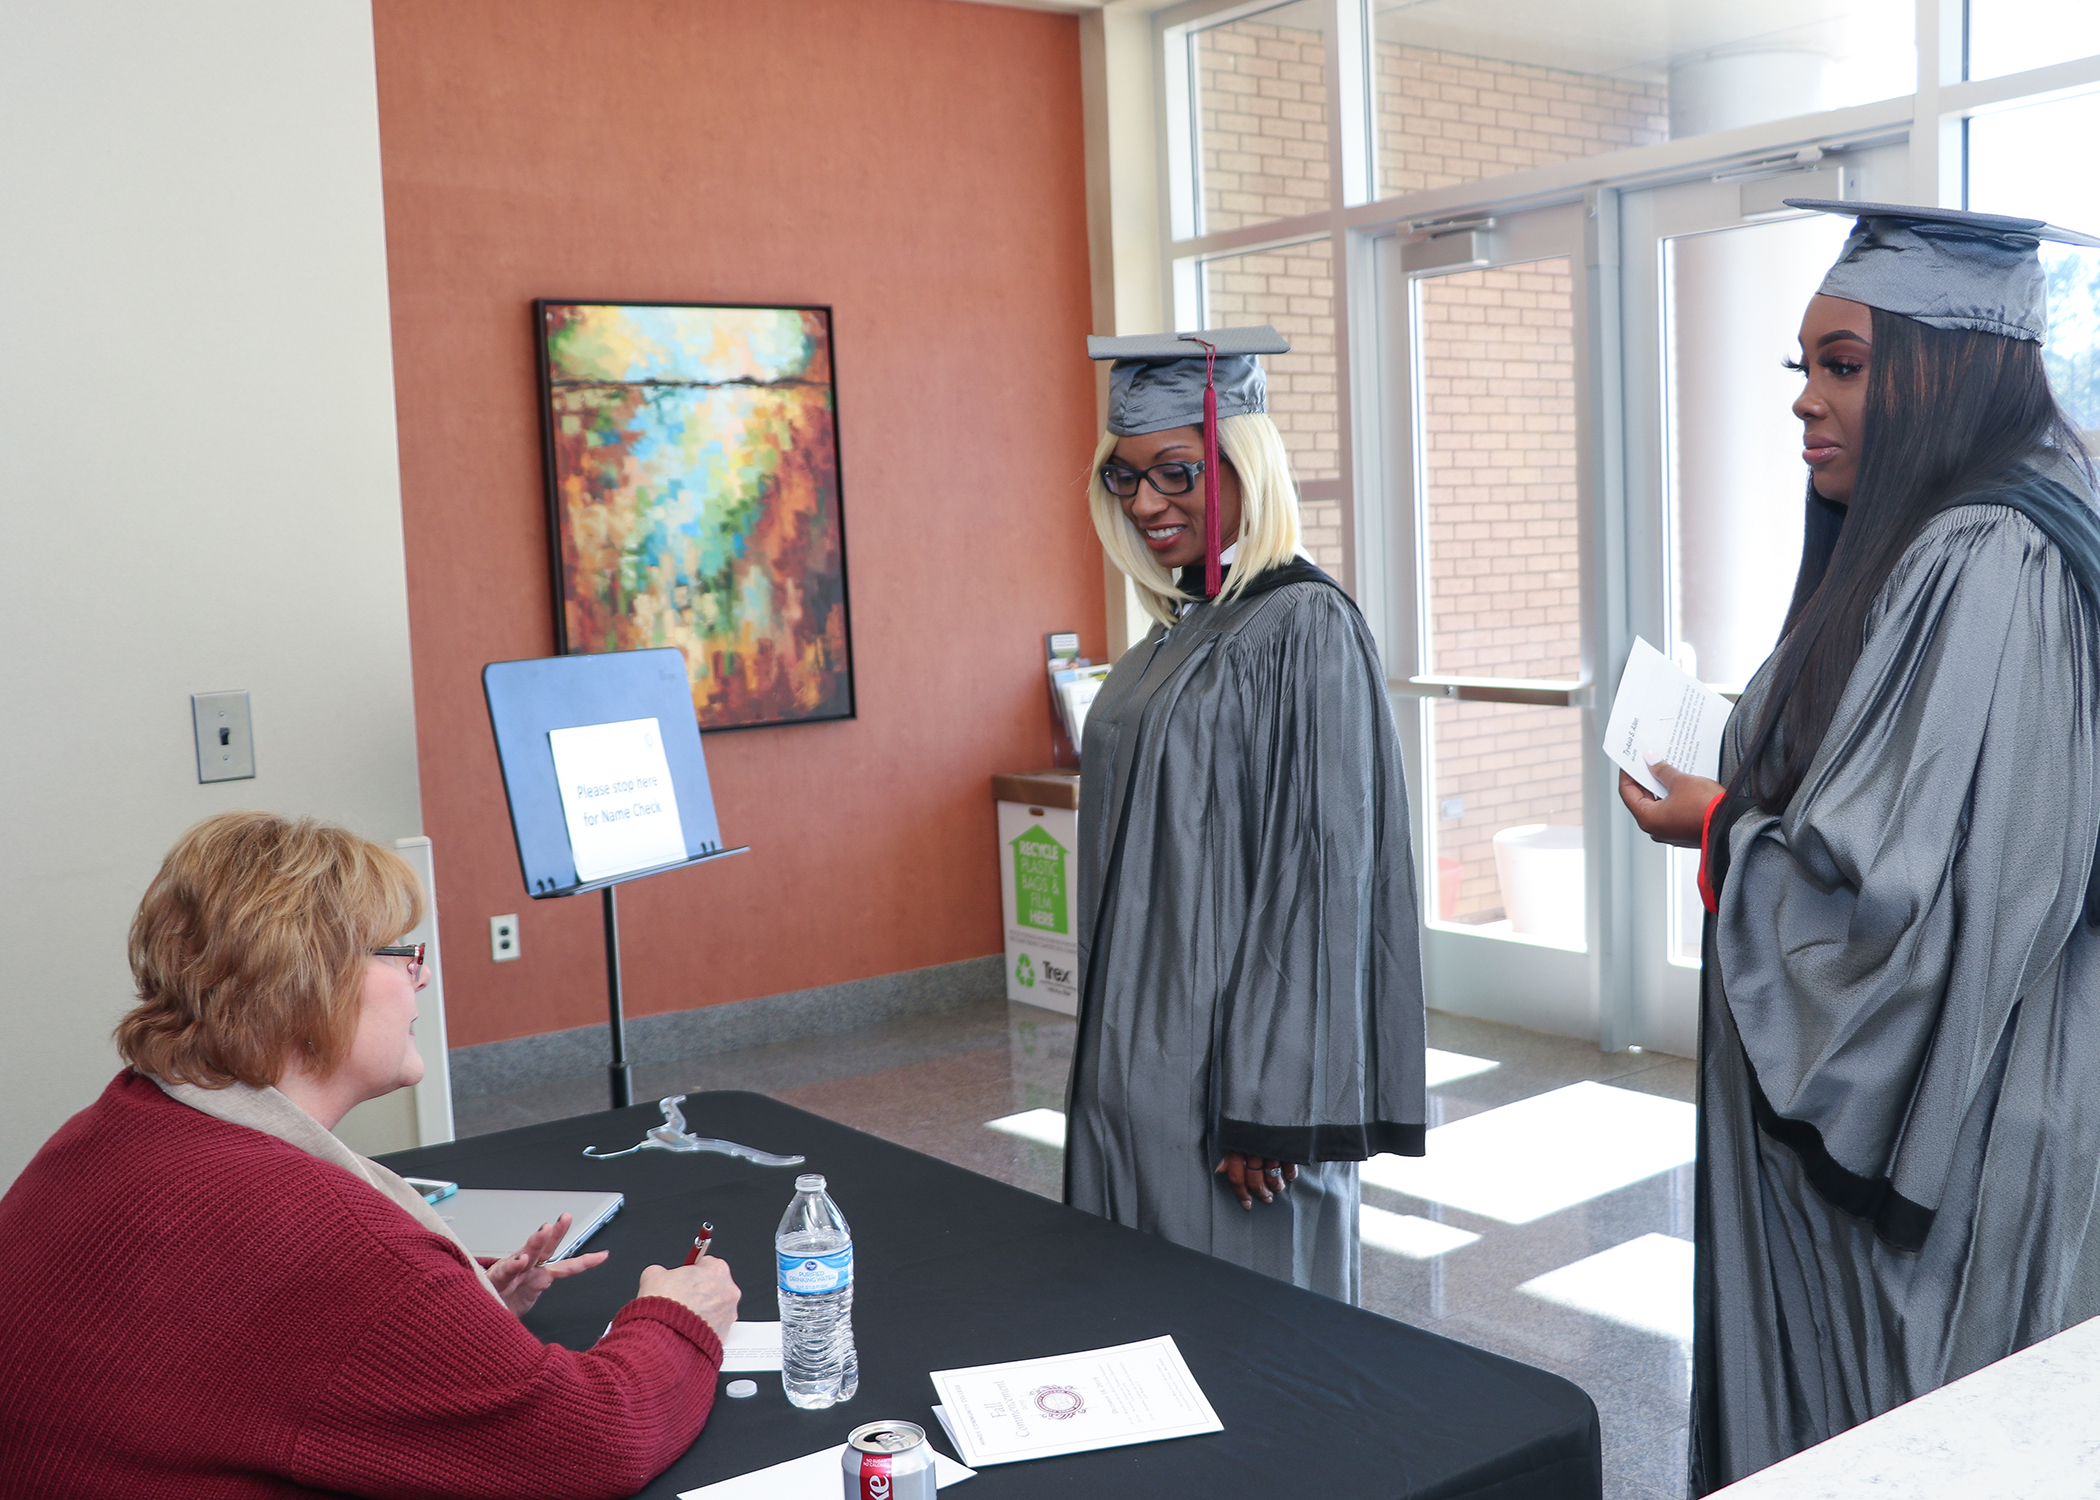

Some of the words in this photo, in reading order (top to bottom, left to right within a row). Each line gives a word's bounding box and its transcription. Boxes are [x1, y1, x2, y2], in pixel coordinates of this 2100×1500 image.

[577, 783, 611, 799] Please
[613, 780, 635, 794] stop
[636, 774, 658, 789] here
[583, 812, 599, 827] for
[601, 808, 631, 823] Name
[633, 799, 662, 817] Check
[1020, 841, 1059, 860] RECYCLE
[1021, 857, 1059, 877] PLASTIC
[1022, 873, 1048, 893] BAGS
[1052, 879, 1060, 895] &
[1030, 892, 1052, 909] FILM
[1029, 909, 1055, 928] HERE
[1042, 960, 1072, 983] Trex
[954, 1384, 968, 1403] COLLEGE
[983, 1401, 1007, 1418] Fall
[992, 1380, 1031, 1438] Commencement
